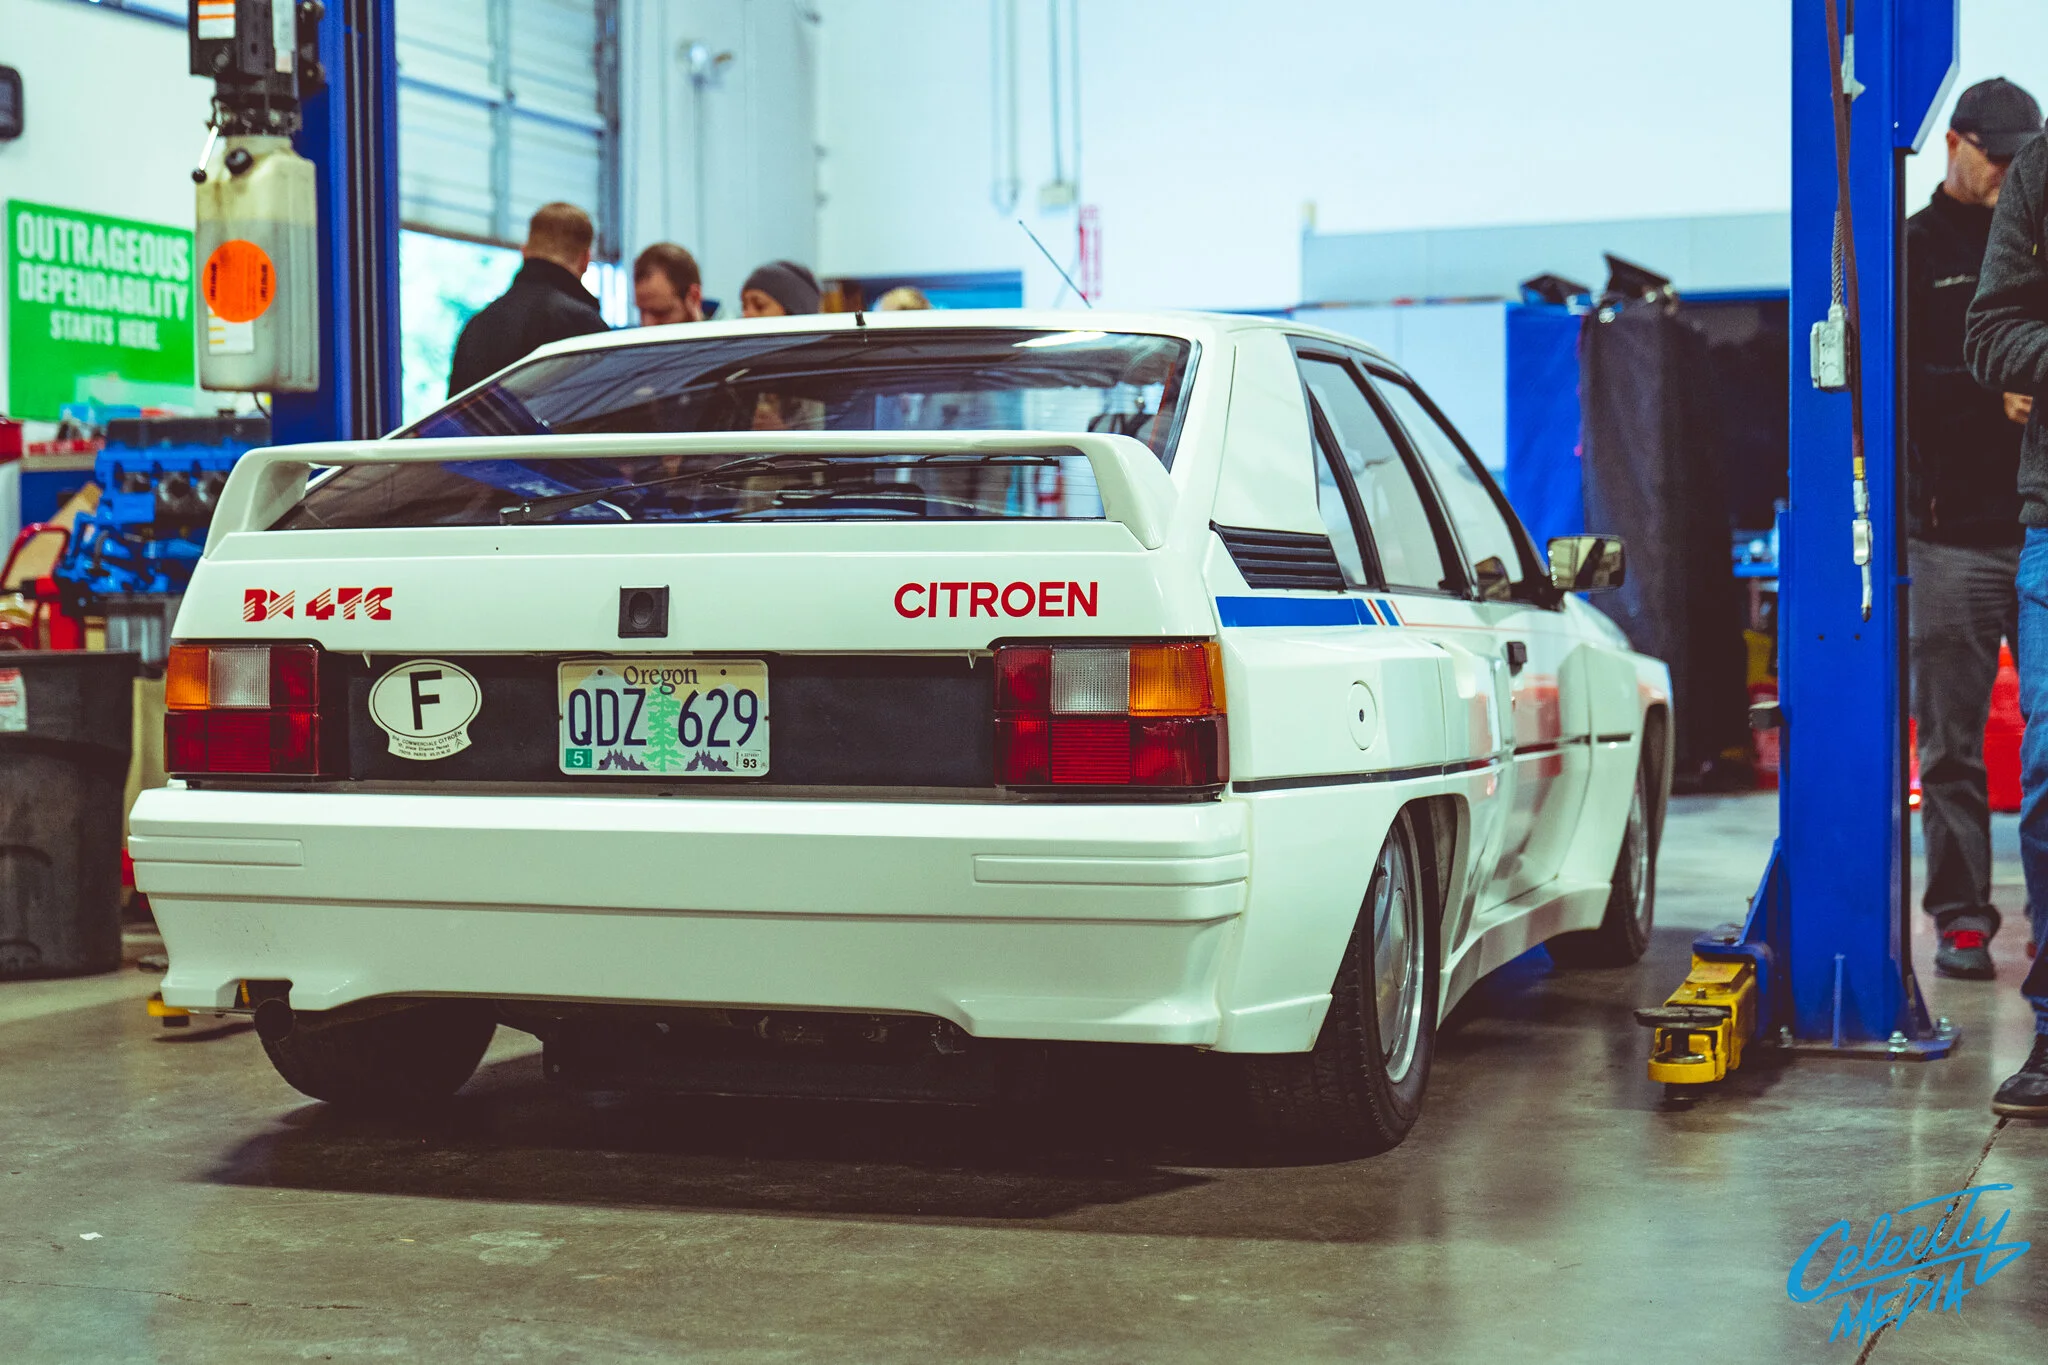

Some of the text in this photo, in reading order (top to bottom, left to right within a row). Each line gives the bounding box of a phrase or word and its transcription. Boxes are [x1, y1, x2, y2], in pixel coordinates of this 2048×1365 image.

[16, 210, 191, 282] OUTRAGEOUS
[17, 261, 190, 321] DEPENDABILITY
[50, 309, 115, 346] STARTS
[243, 587, 393, 622] BX 4TC
[894, 581, 1098, 619] CITROEN
[623, 665, 701, 696] Oregon
[409, 669, 443, 731] F
[568, 688, 758, 748] QDZ 629
[573, 751, 584, 766] 5
[742, 758, 757, 769] 93
